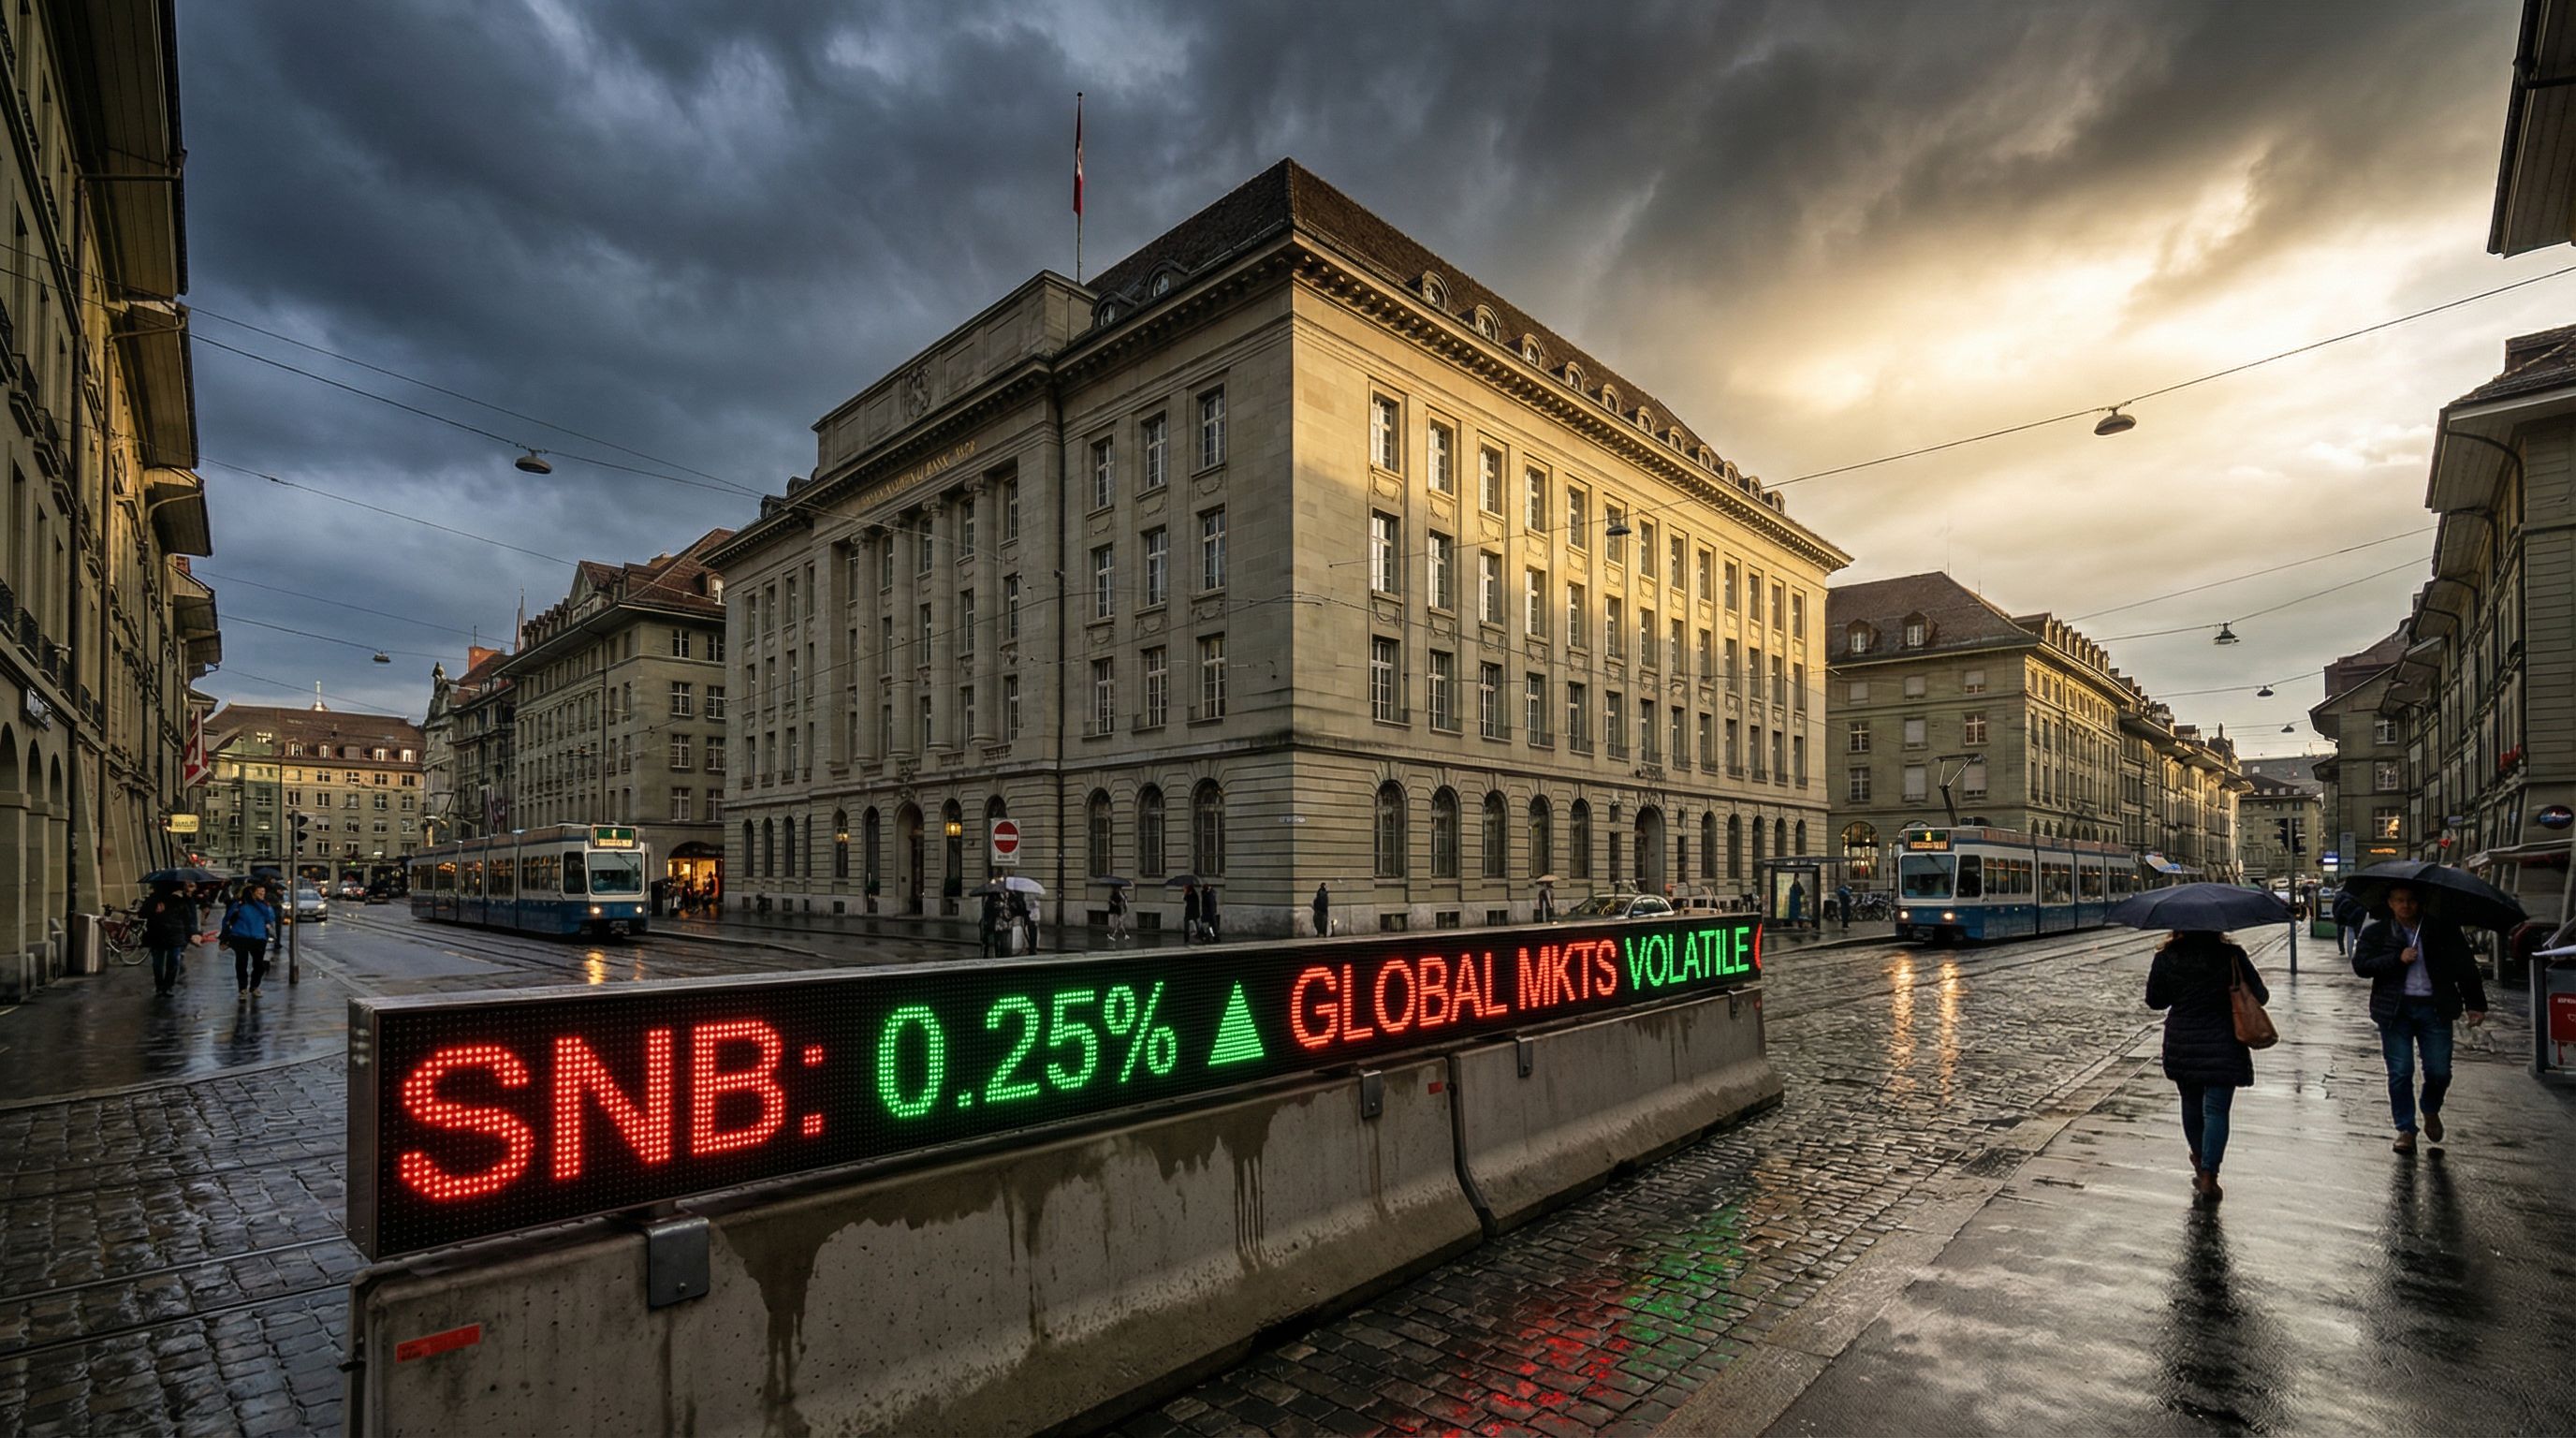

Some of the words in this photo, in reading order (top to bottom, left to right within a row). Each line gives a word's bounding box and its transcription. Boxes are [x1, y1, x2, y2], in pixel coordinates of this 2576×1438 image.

[400, 1019, 824, 1200] SNB:
[877, 981, 1178, 1120] 0.25%
[1291, 952, 1509, 1049] GLOBAL
[1518, 939, 1618, 1010] MKTS
[1624, 926, 1749, 990] VOLATILE
